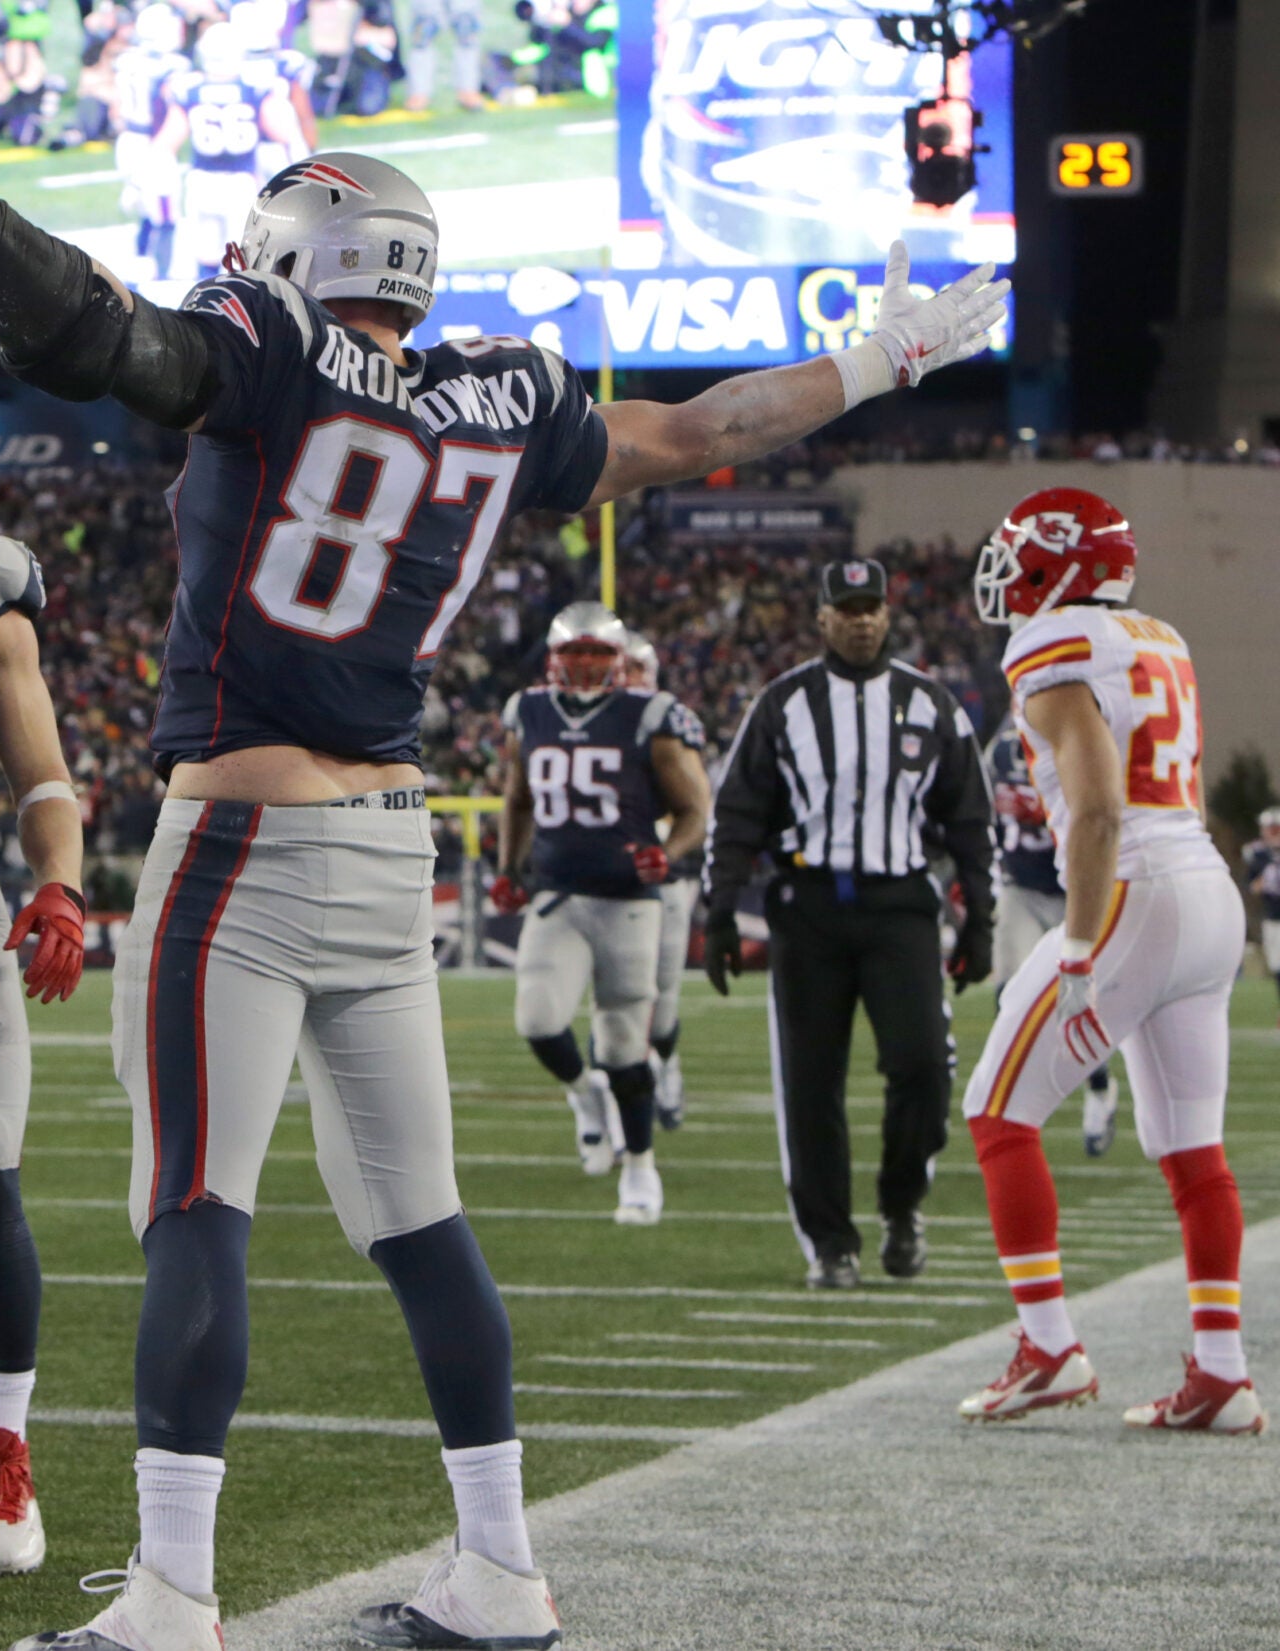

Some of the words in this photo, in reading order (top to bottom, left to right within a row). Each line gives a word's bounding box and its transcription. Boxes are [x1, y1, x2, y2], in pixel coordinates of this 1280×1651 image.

[1059, 141, 1131, 188] 25
[376, 278, 433, 309] PATRIOTS
[586, 277, 788, 352] VISA
[245, 411, 525, 661] 87
[528, 746, 621, 828] 85
